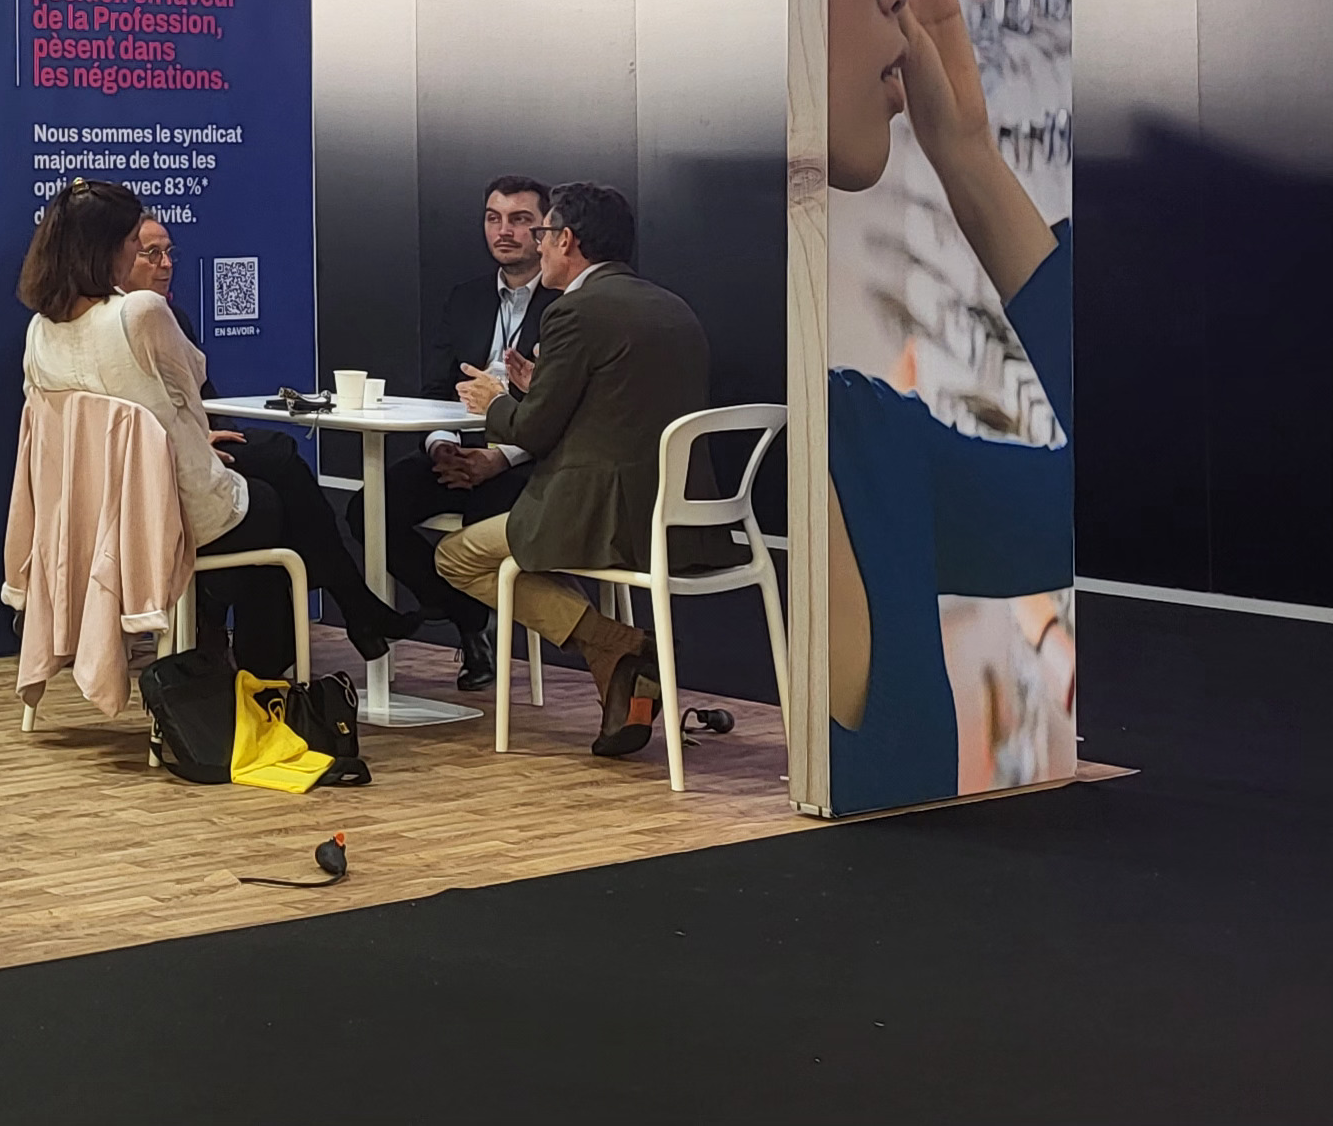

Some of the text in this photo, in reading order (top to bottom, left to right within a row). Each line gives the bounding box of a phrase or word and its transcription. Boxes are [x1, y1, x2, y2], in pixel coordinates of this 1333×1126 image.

[33, 4, 222, 38] de la Profession,
[33, 33, 175, 64] pèsent dans
[33, 60, 229, 94] les négociations.
[34, 124, 243, 146] Nous sommes le syndicat
[34, 150, 216, 174] majoritaire de tous les
[215, 327, 254, 336] EN SAVOIR
